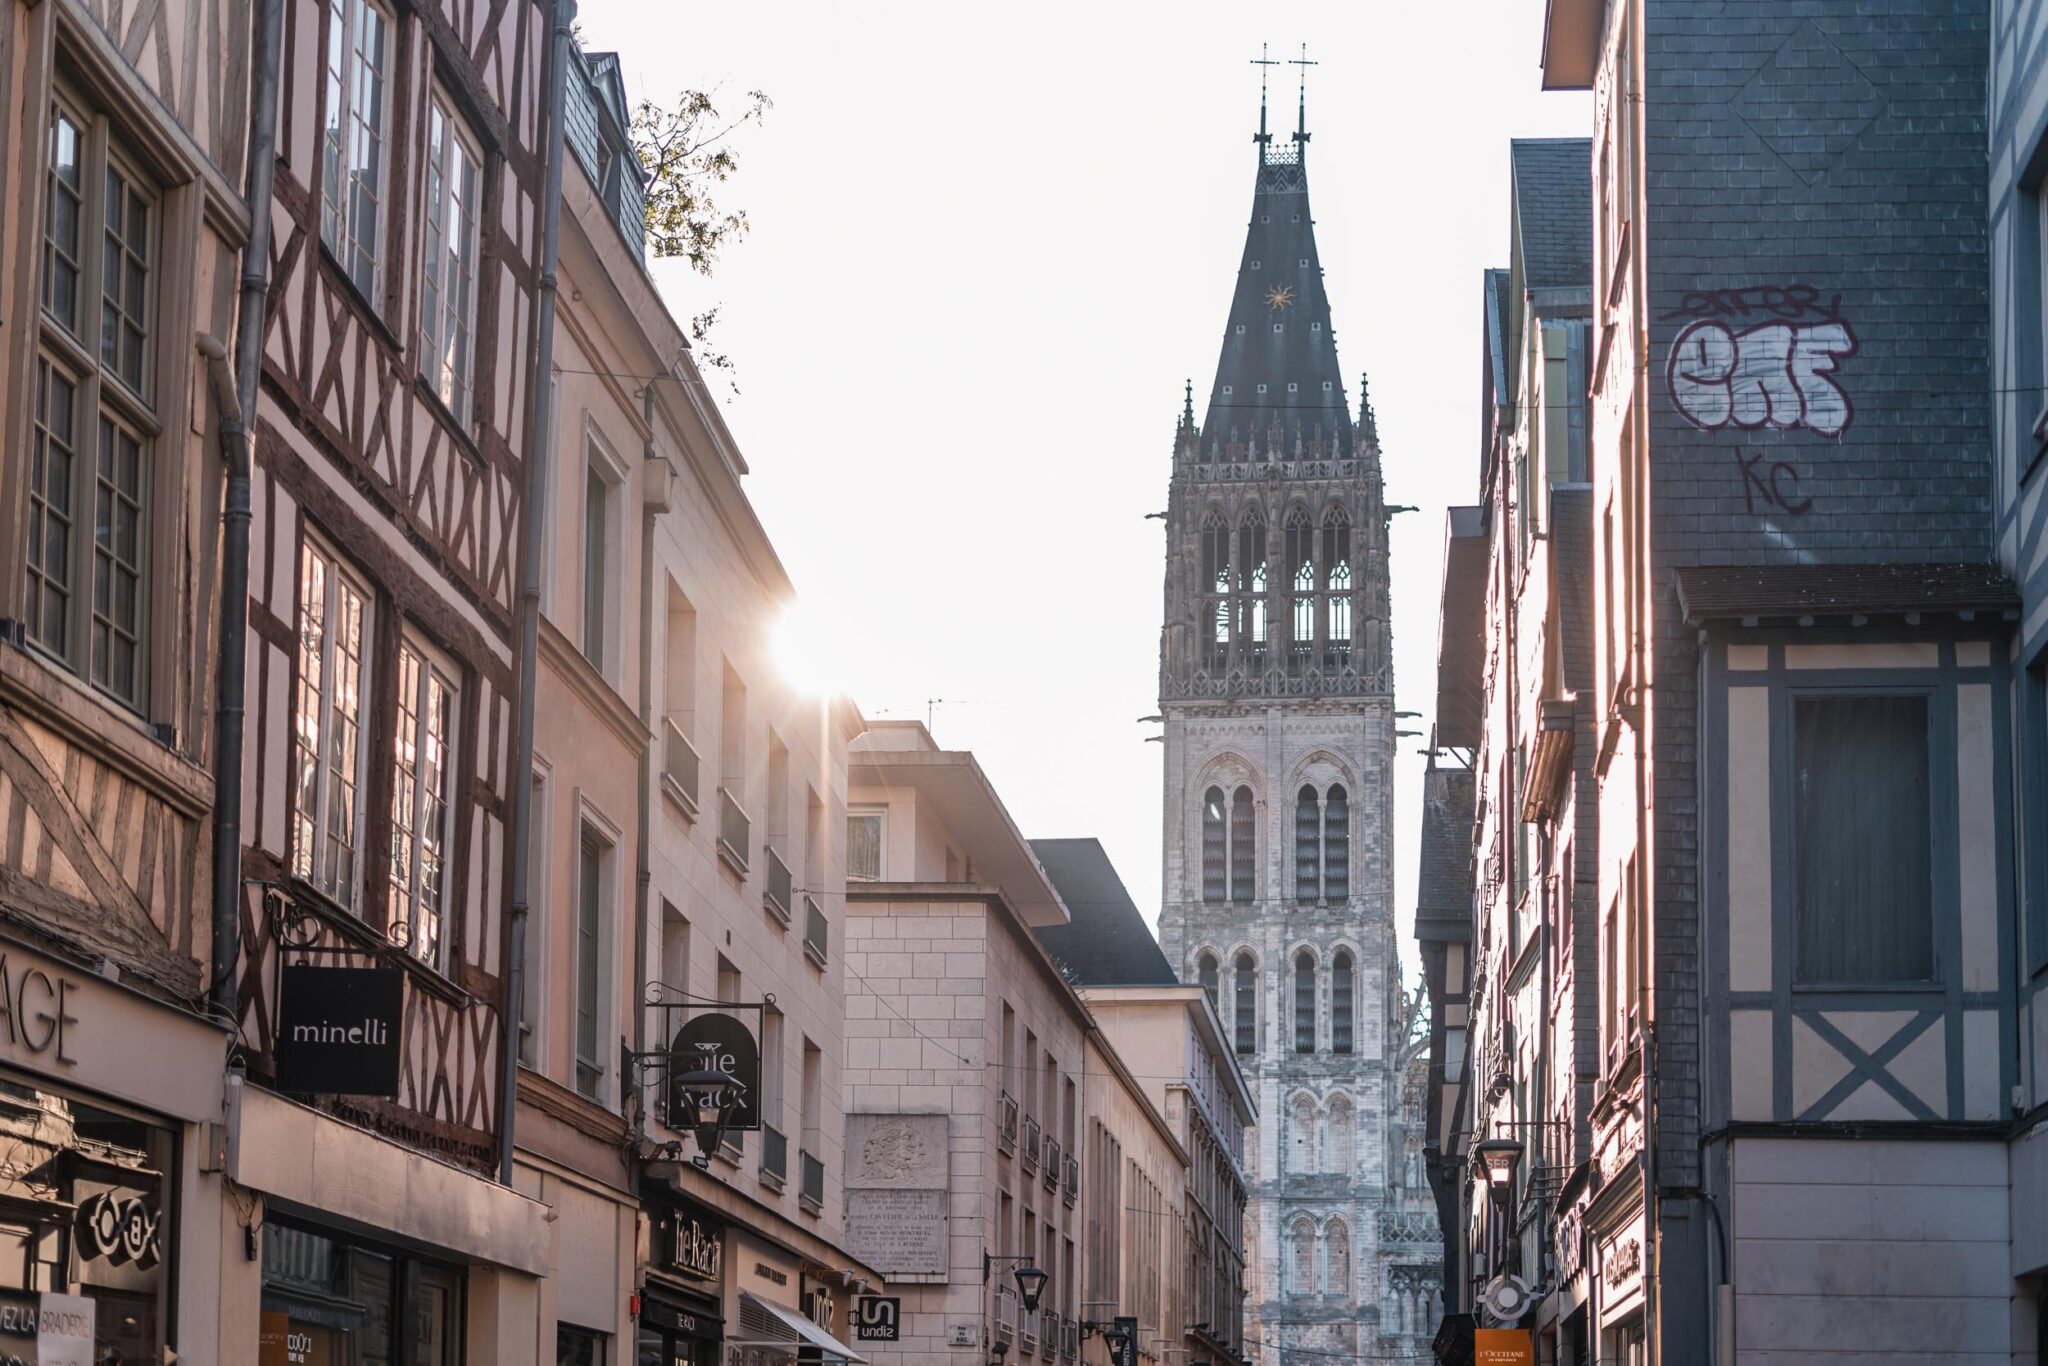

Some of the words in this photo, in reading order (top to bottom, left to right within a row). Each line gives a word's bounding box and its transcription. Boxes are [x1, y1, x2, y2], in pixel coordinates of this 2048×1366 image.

[292, 1019, 387, 1046] minelli
[21, 1307, 36, 1332] LA
[862, 1325, 894, 1338] undiz
[1480, 1350, 1525, 1358] L'OCCITANE
